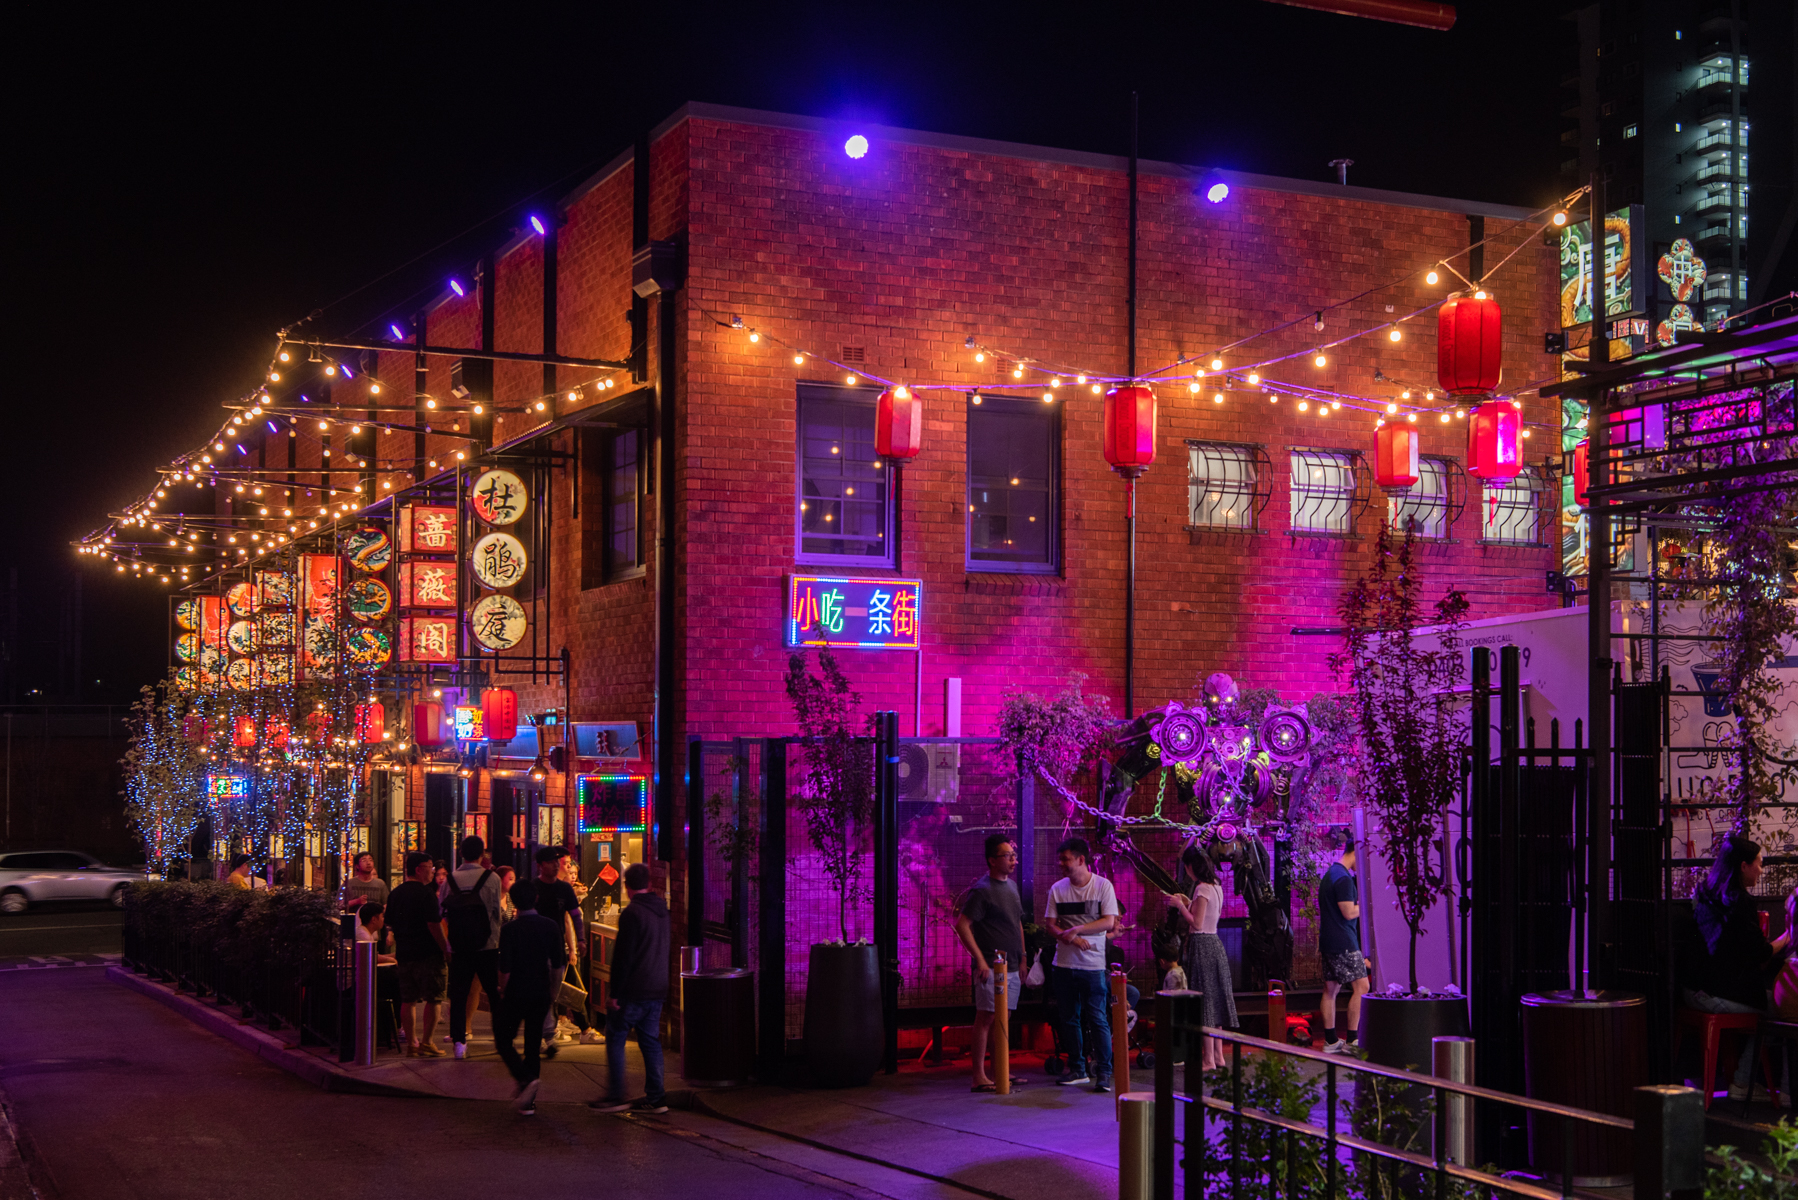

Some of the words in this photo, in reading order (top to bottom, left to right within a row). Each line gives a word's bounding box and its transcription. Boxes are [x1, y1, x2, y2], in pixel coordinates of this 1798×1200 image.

[479, 478, 517, 643] 杜鹃庭
[418, 513, 452, 658] 蔷薇阁
[797, 587, 916, 637] 小吃一条街
[1465, 636, 1496, 647] BOOKINGS
[592, 782, 634, 803] 炸串
[585, 804, 641, 826] 烤冷面
